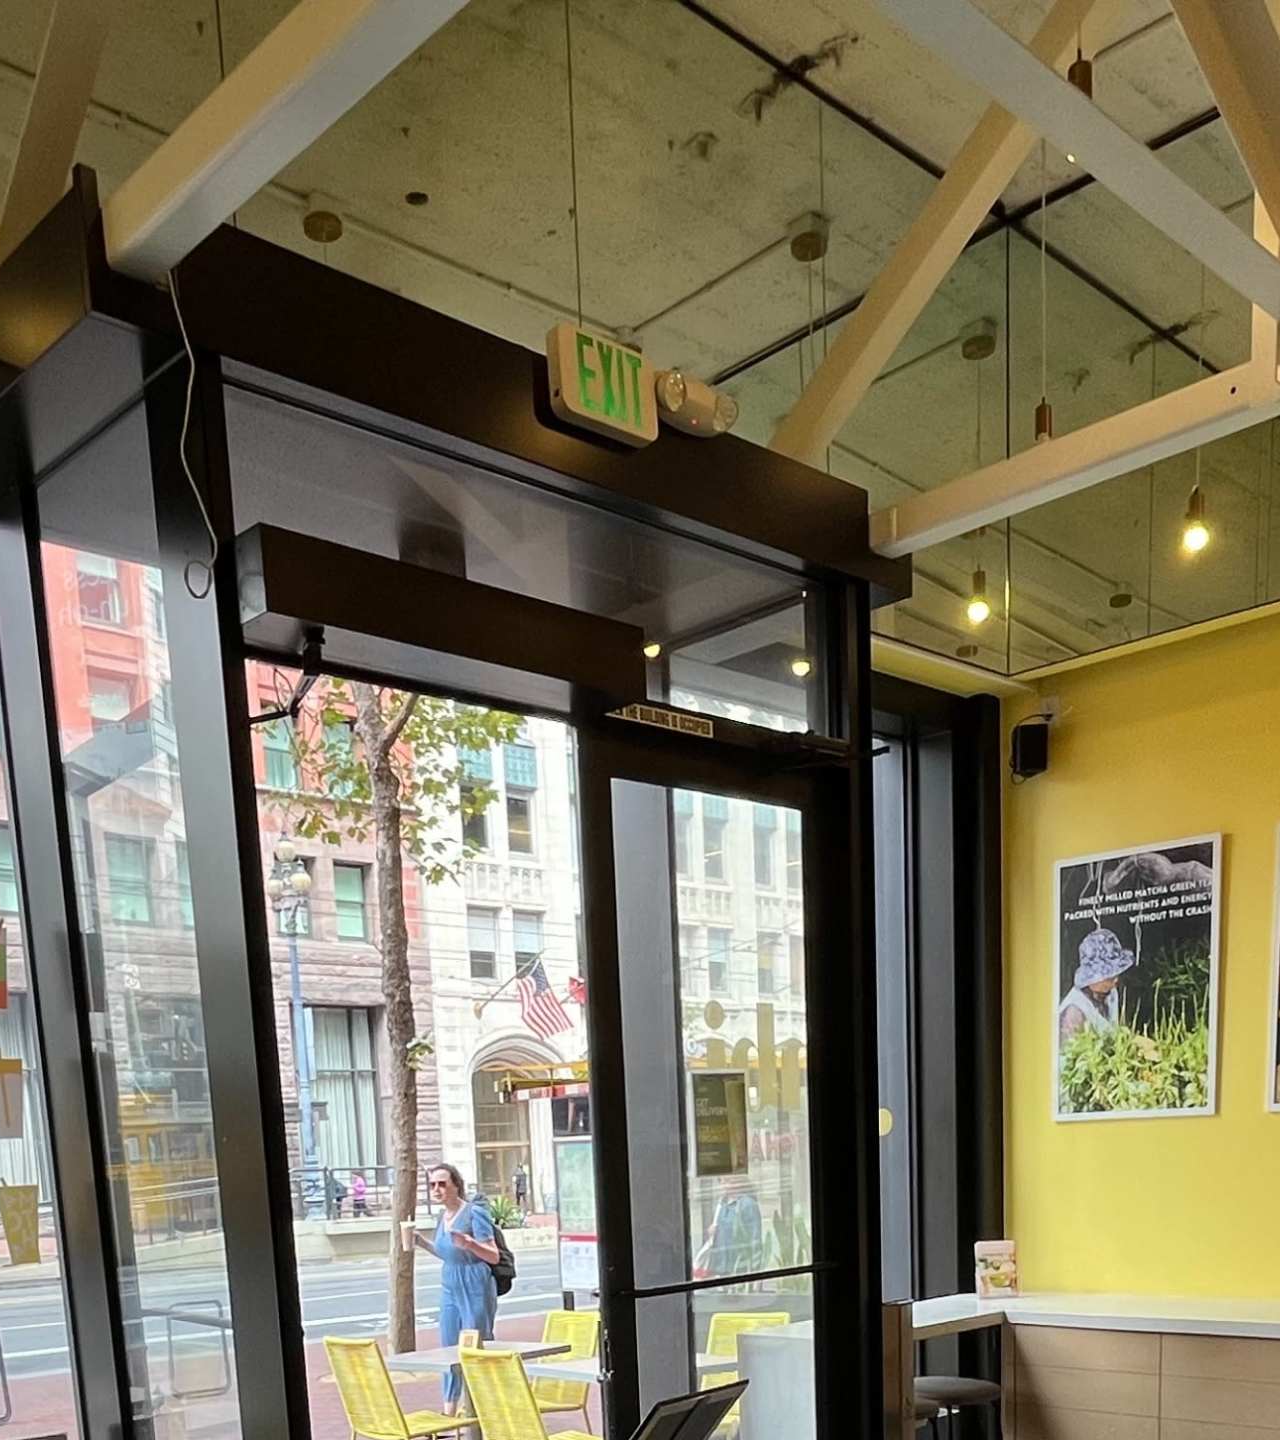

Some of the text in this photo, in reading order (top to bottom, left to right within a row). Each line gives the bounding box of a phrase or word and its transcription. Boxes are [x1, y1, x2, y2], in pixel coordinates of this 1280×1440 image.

[575, 332, 643, 429] EXIT
[1064, 891, 1213, 921] PACKED WITH NUTRIENTS AND ENERGY
[1079, 895, 1104, 907] FINELY
[1105, 890, 1133, 903] MILLED
[1134, 884, 1168, 897] MATCHA
[1170, 881, 1196, 893] GREEN
[1129, 910, 1167, 924] WITHOUT
[1169, 908, 1183, 919] THE
